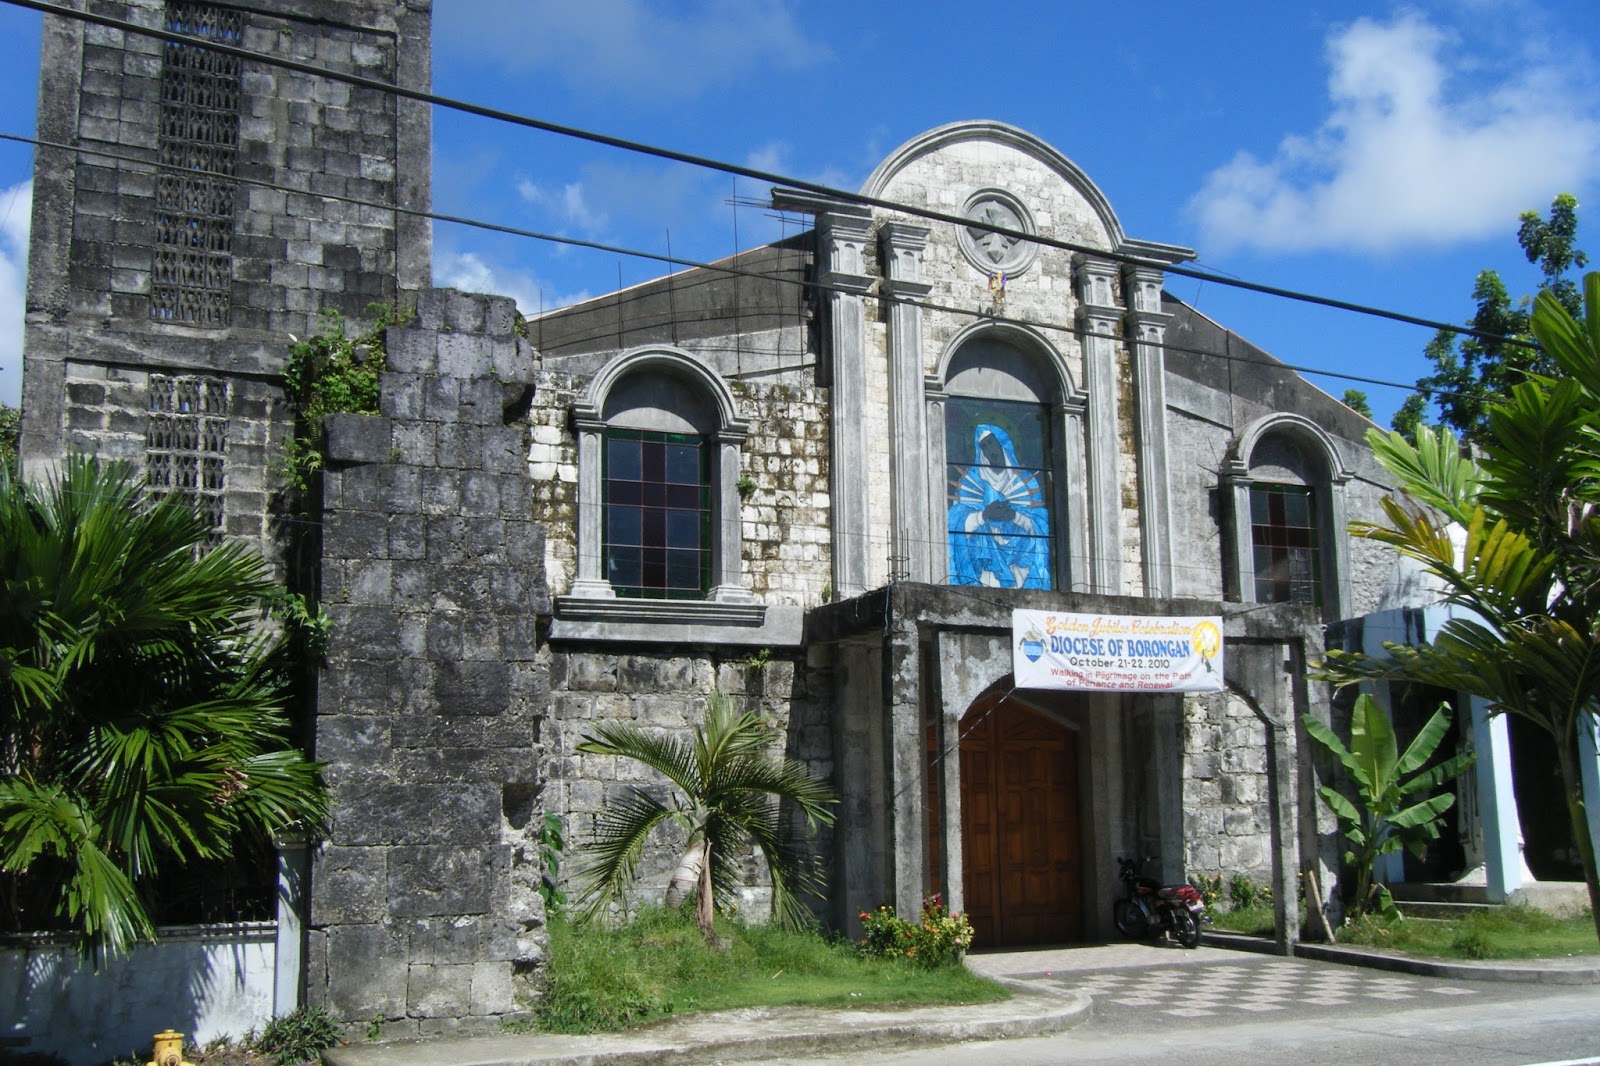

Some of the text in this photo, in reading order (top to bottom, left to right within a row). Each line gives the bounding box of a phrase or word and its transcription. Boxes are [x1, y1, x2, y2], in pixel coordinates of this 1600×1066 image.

[1046, 616, 1192, 637] Golden Jubilee Celebration
[1050, 636, 1190, 658] DIOCESE OF BORONGAN
[1070, 657, 1115, 668] October
[1051, 669, 1084, 679] Walking
[1086, 671, 1092, 679] in
